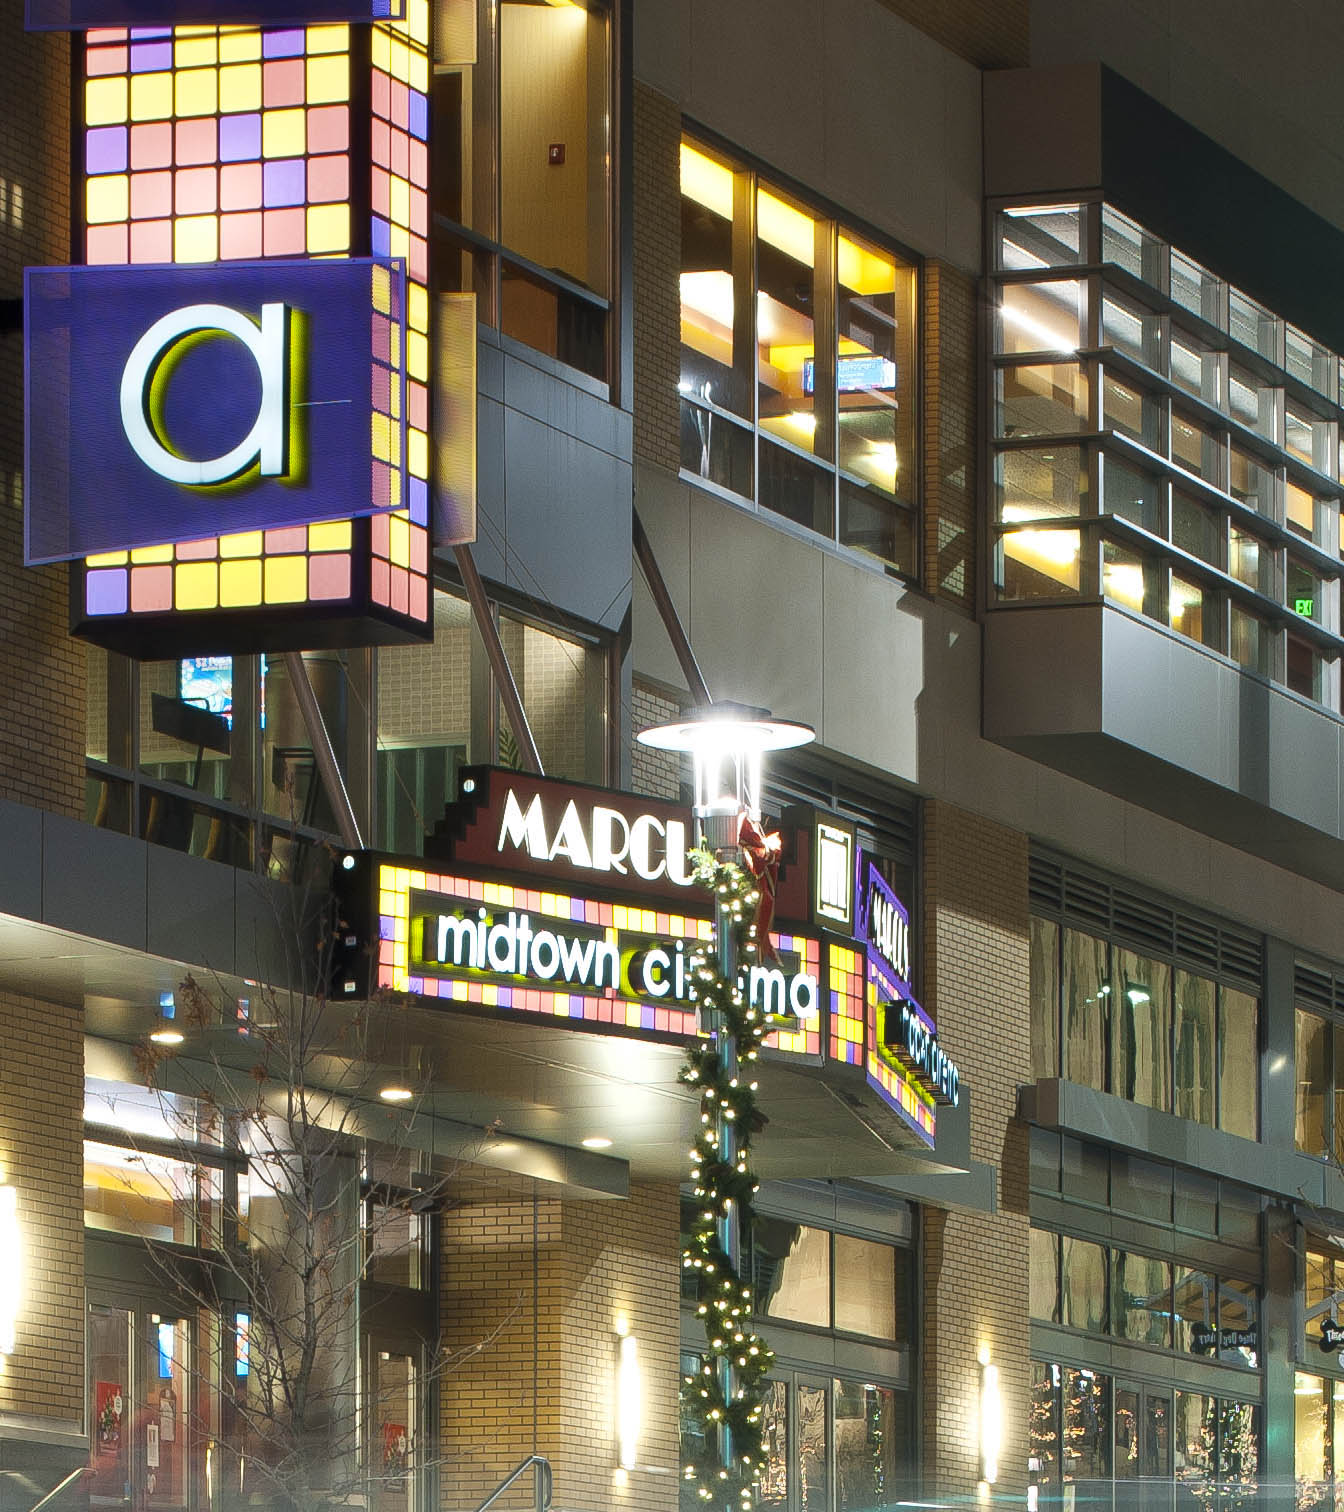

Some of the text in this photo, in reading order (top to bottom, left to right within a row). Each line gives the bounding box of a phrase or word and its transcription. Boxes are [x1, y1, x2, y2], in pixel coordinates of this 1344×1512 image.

[497, 788, 696, 887] MARCU
[437, 905, 818, 1019] midtown cima
